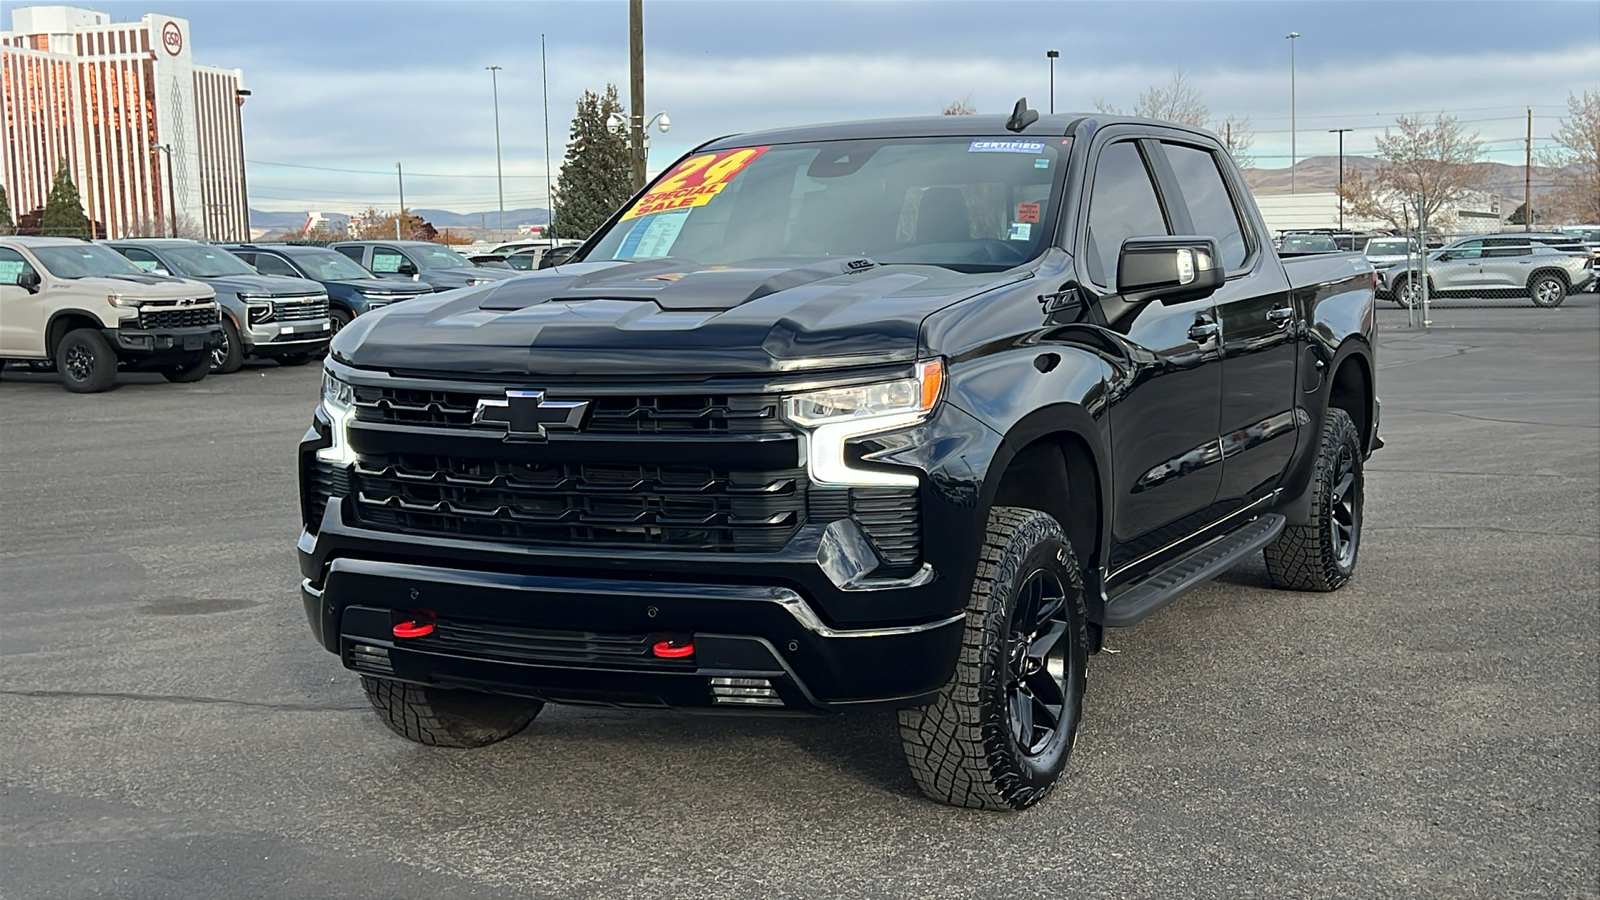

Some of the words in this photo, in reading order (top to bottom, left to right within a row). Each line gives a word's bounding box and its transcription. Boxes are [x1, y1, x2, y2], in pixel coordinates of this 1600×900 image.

[165, 31, 180, 47] GSR
[648, 149, 757, 194] 24
[639, 184, 718, 206] SPECIAL
[634, 197, 697, 216] SALE
